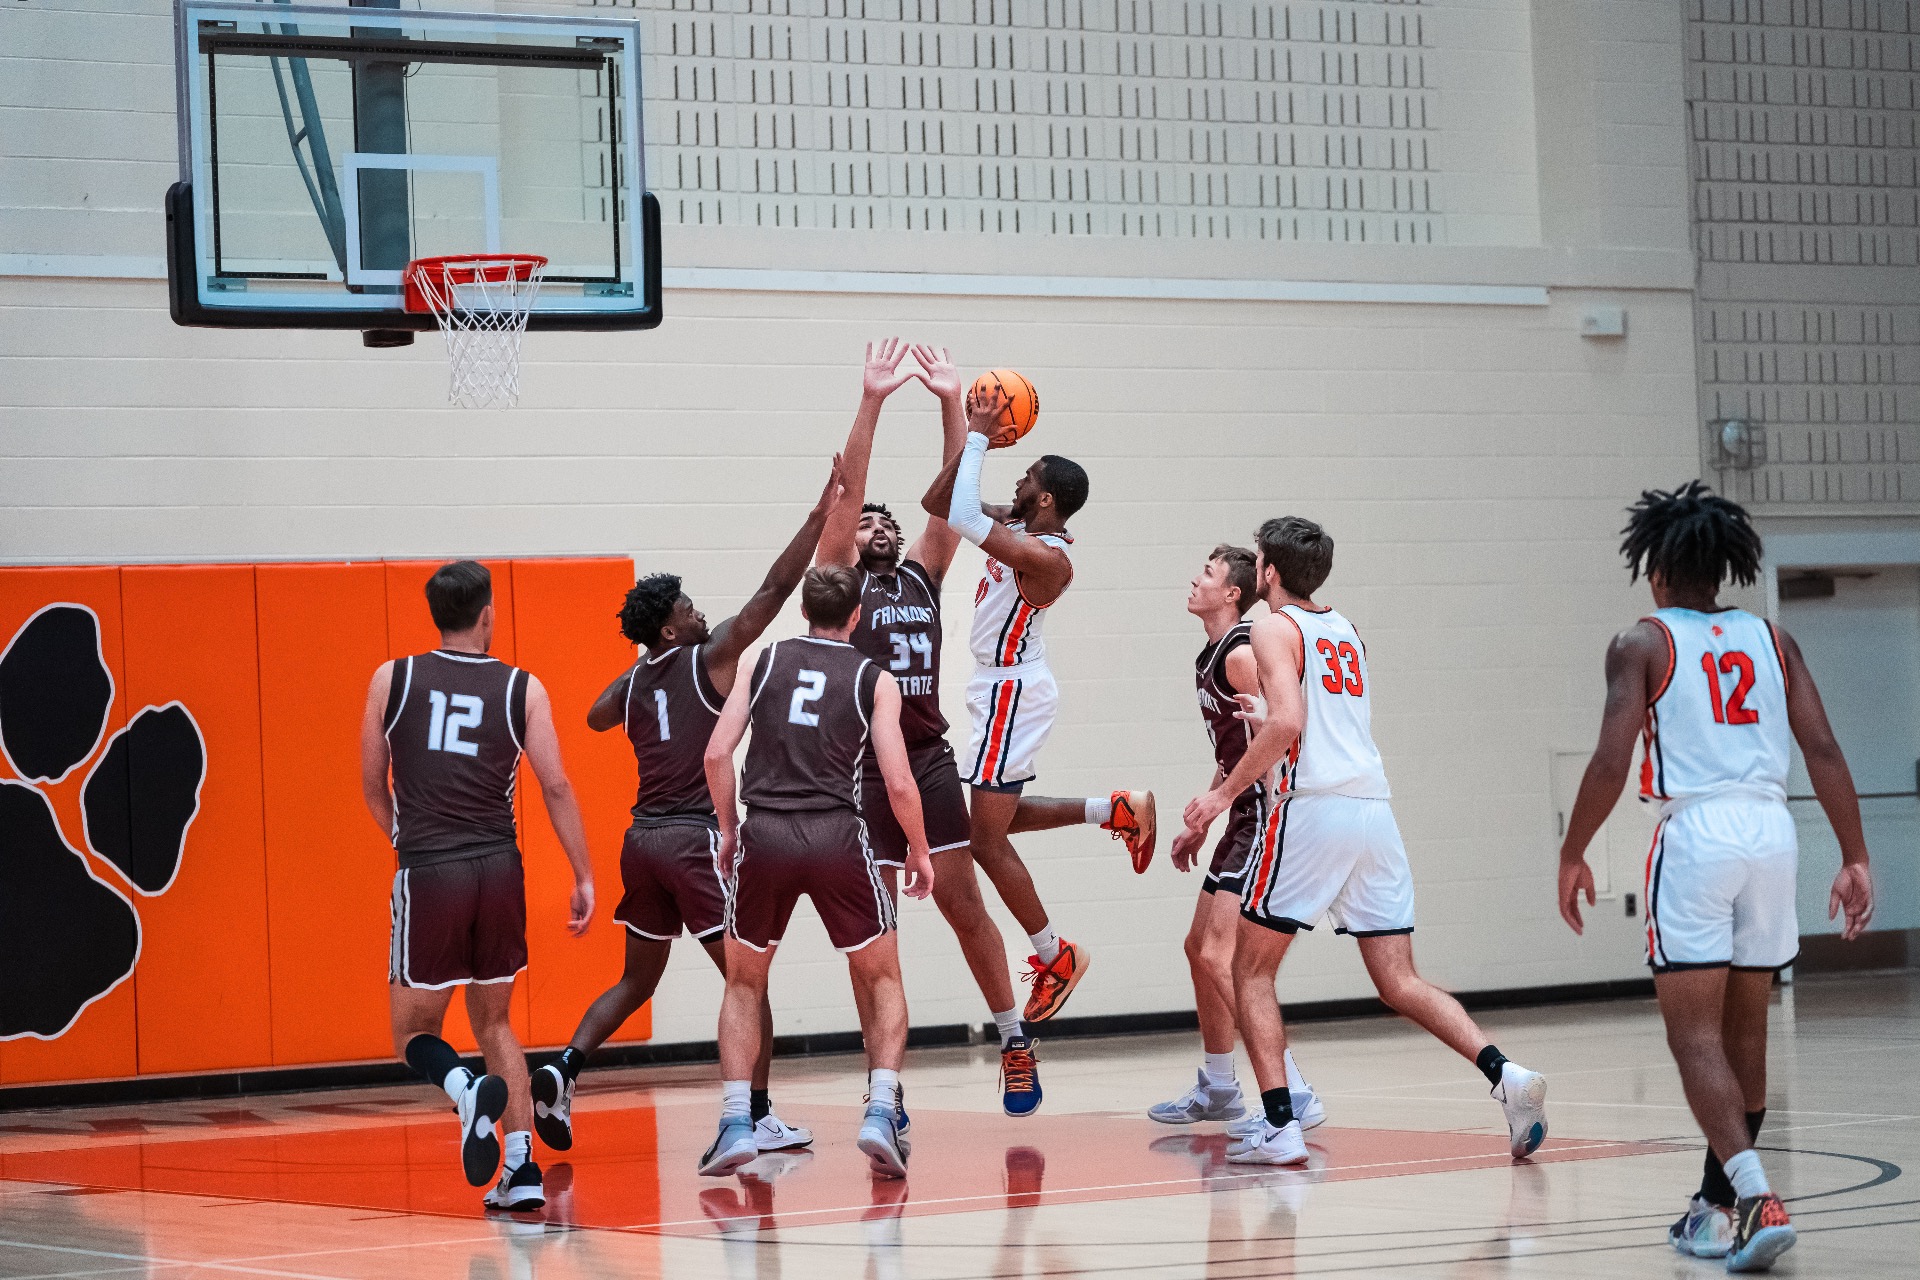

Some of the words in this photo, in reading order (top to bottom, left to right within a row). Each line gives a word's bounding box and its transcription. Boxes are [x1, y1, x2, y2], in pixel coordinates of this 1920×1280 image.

[889, 632, 933, 671] 34
[1316, 637, 1364, 697] 33
[788, 669, 827, 727] 2
[894, 675, 933, 696] TATE
[1701, 651, 1759, 725] 12
[428, 690, 484, 757] 12
[654, 689, 671, 741] 1
